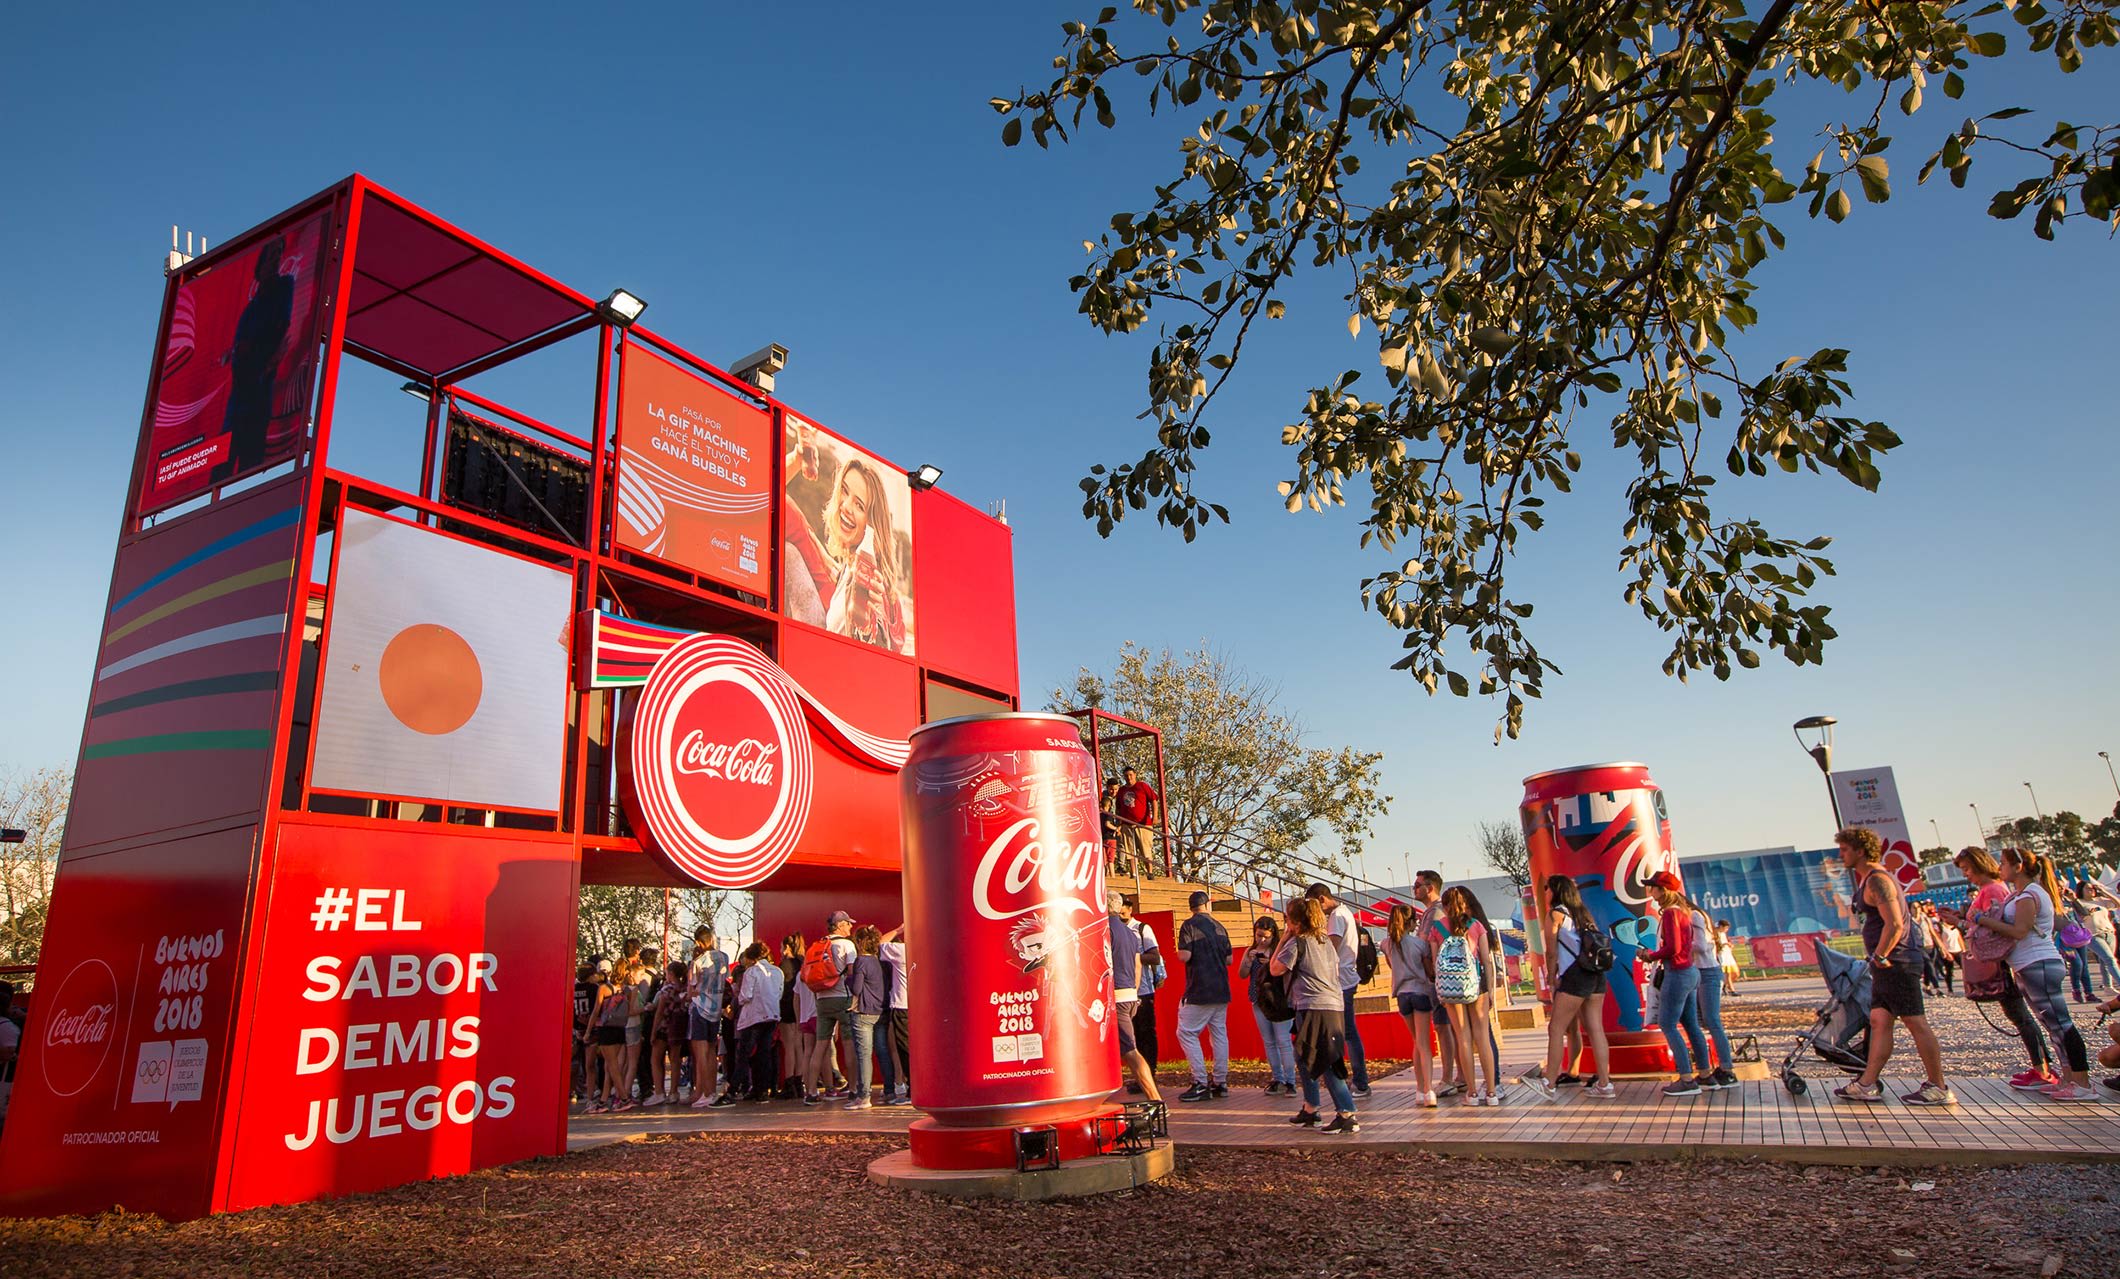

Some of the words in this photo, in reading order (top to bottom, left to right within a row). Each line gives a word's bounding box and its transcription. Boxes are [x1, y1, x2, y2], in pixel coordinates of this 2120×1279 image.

[648, 403, 666, 421] LA
[669, 414, 690, 430] GIF
[693, 425, 750, 463] MACHINE,
[682, 406, 703, 423] PASÁ
[704, 417, 722, 431] POR
[172, 455, 192, 469] PUEDE
[192, 445, 218, 460] QUEDAR
[651, 437, 689, 463] GANÁ
[691, 454, 747, 488] BUBBLES
[660, 424, 688, 446] HACÉ
[691, 439, 703, 453] EL
[705, 445, 732, 465] TUYO
[733, 459, 740, 468] Y
[158, 474, 167, 483] TU
[167, 470, 178, 480] GIF
[676, 729, 779, 786] Coca-Cola
[310, 887, 422, 931] #EL
[1703, 891, 1760, 910] futuro
[154, 929, 224, 964] BUENOS
[159, 962, 208, 994] AIRES
[302, 952, 498, 1002] SABOR
[154, 995, 203, 1032] 2018
[990, 988, 1040, 1005] BUENOS
[997, 1001, 1033, 1017] AIRES
[47, 1004, 114, 1047] Coca-Cola
[999, 1016, 1034, 1034] 2018
[296, 1015, 481, 1075] DEMIS
[983, 1070, 1031, 1080] PATROCINADOR
[1031, 1067, 1055, 1076] OFICIAL
[284, 1075, 516, 1151] JUEGOS
[62, 1131, 127, 1145] PATROCINADOR
[127, 1130, 160, 1143] OFICIAL
